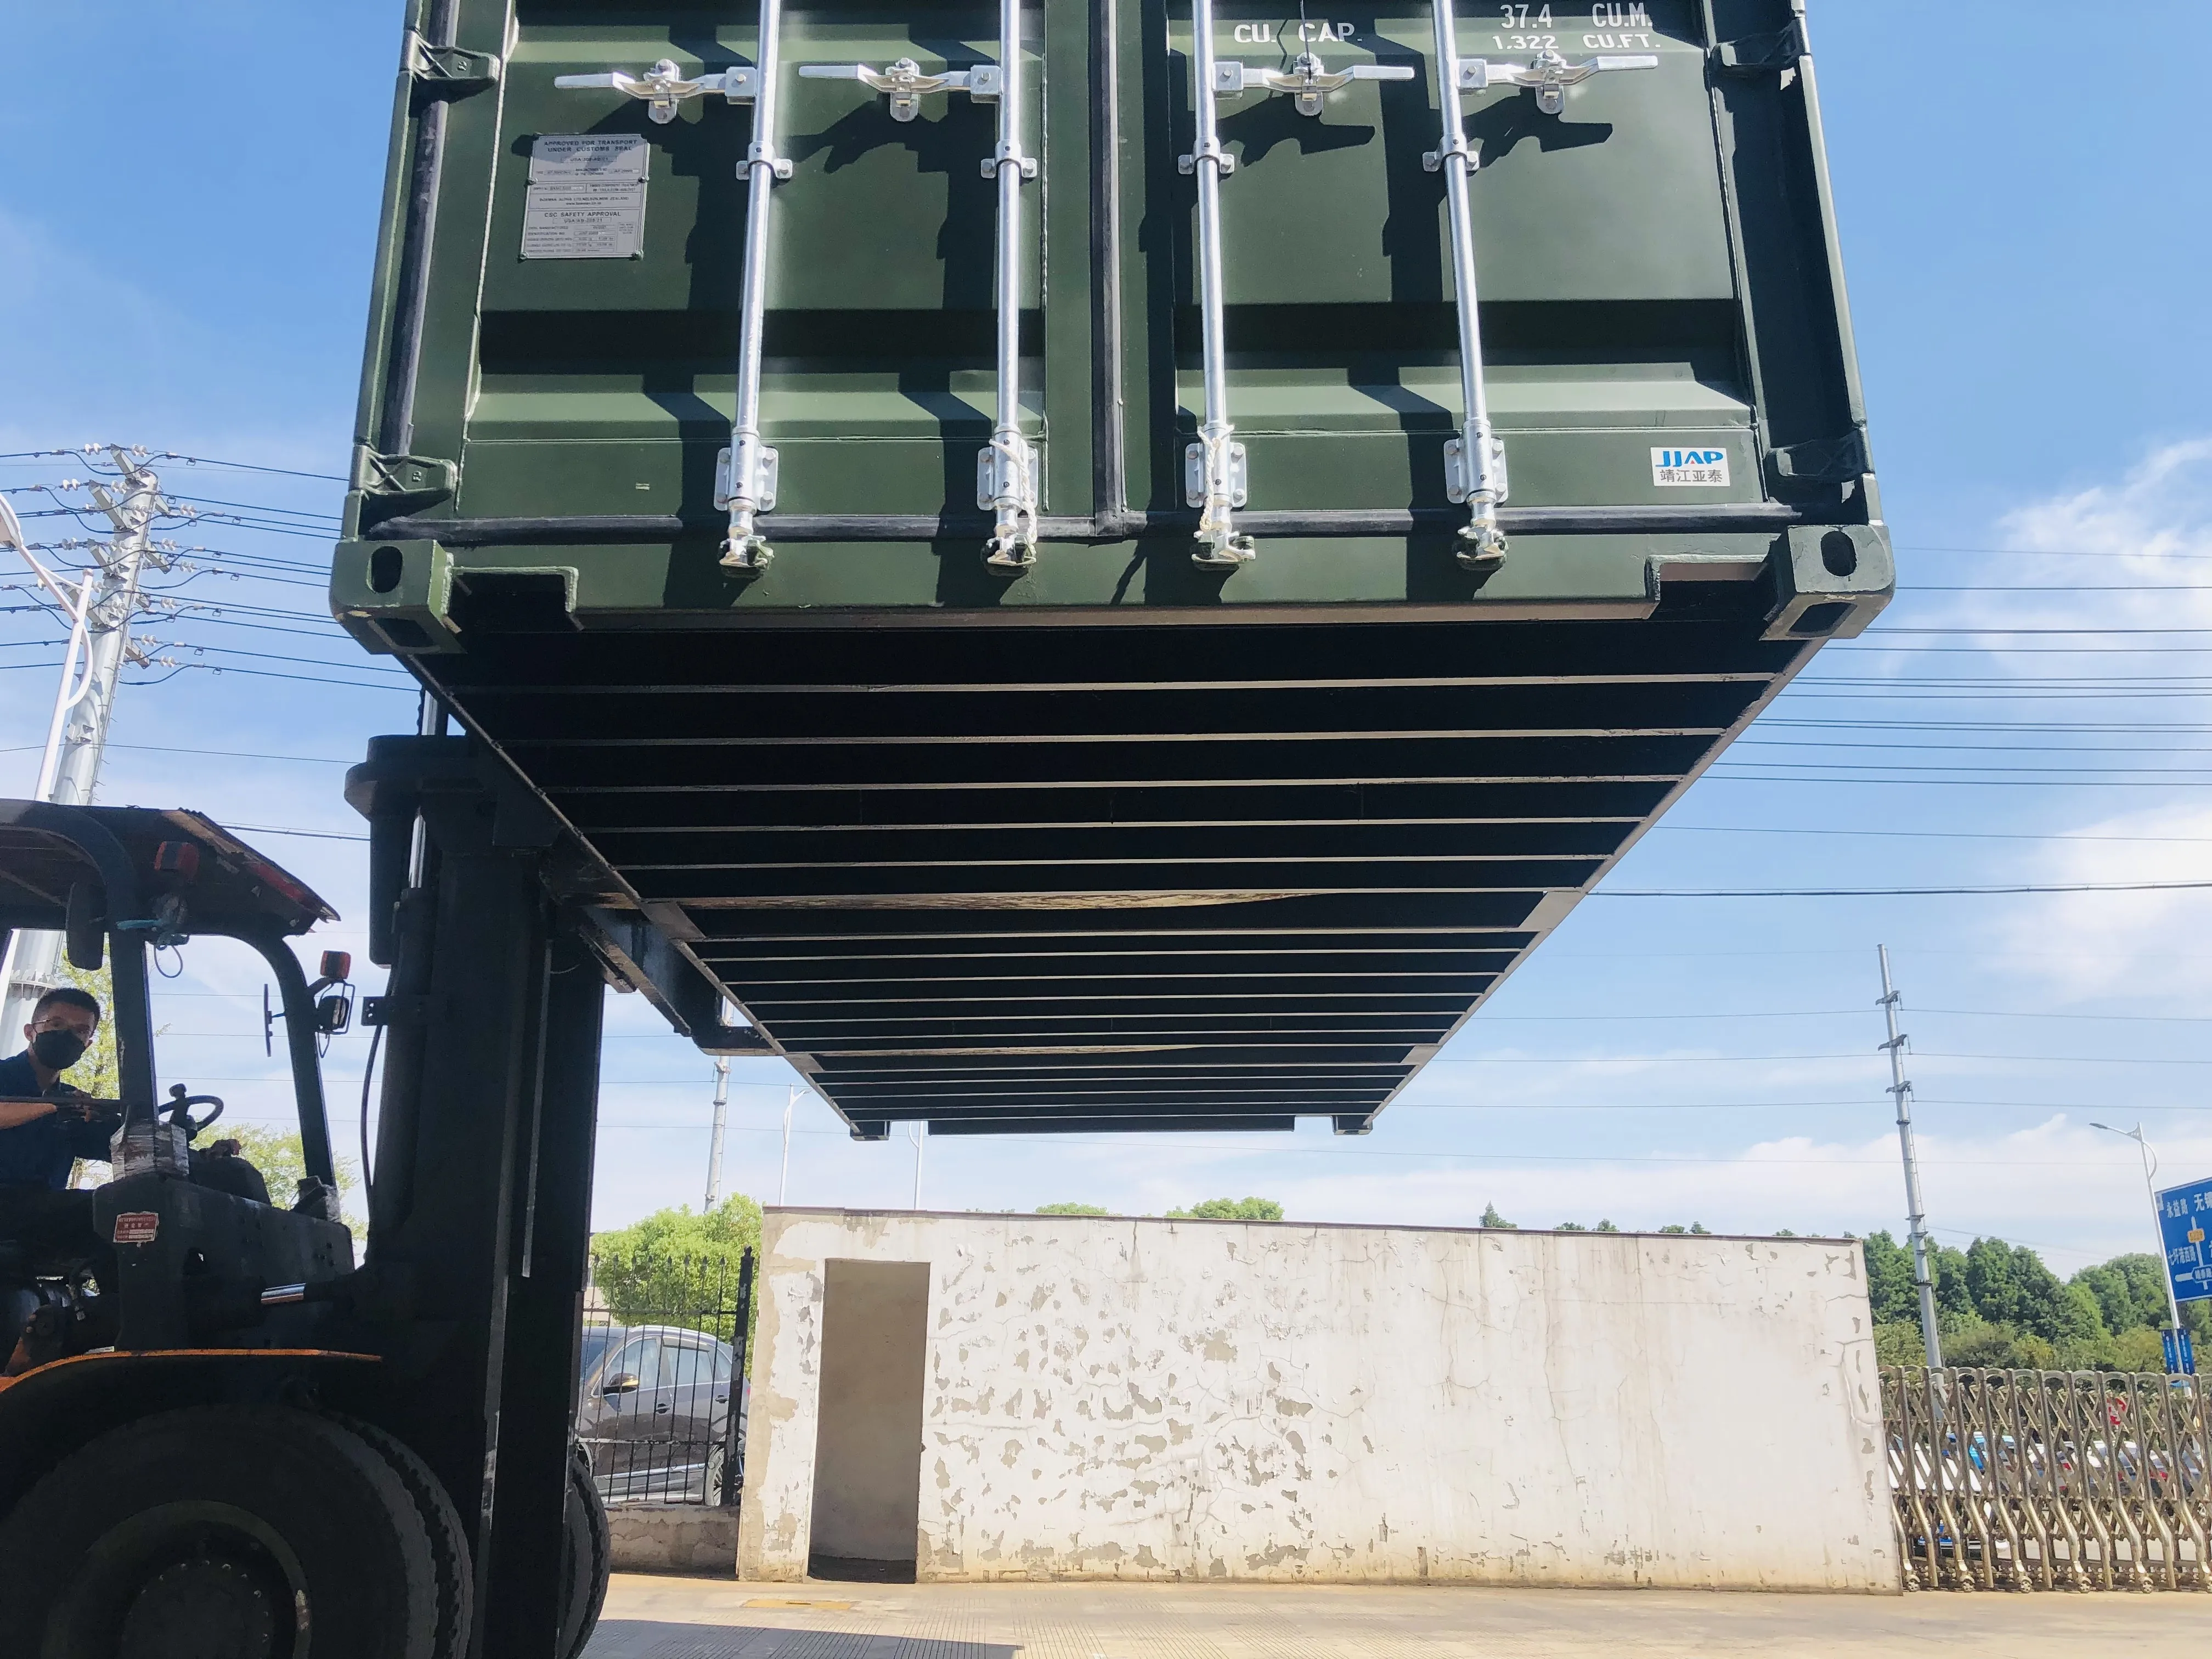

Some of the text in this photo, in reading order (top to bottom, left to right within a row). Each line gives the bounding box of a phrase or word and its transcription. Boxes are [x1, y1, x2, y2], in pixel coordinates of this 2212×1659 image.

[1500, 2, 1653, 29] 37.4 CU.M.
[1234, 22, 1363, 43] CU. CAP.
[1582, 33, 1662, 49] CU.FT.
[1655, 450, 1724, 467] JJAP
[1659, 469, 1723, 483] 靖江亚泰
